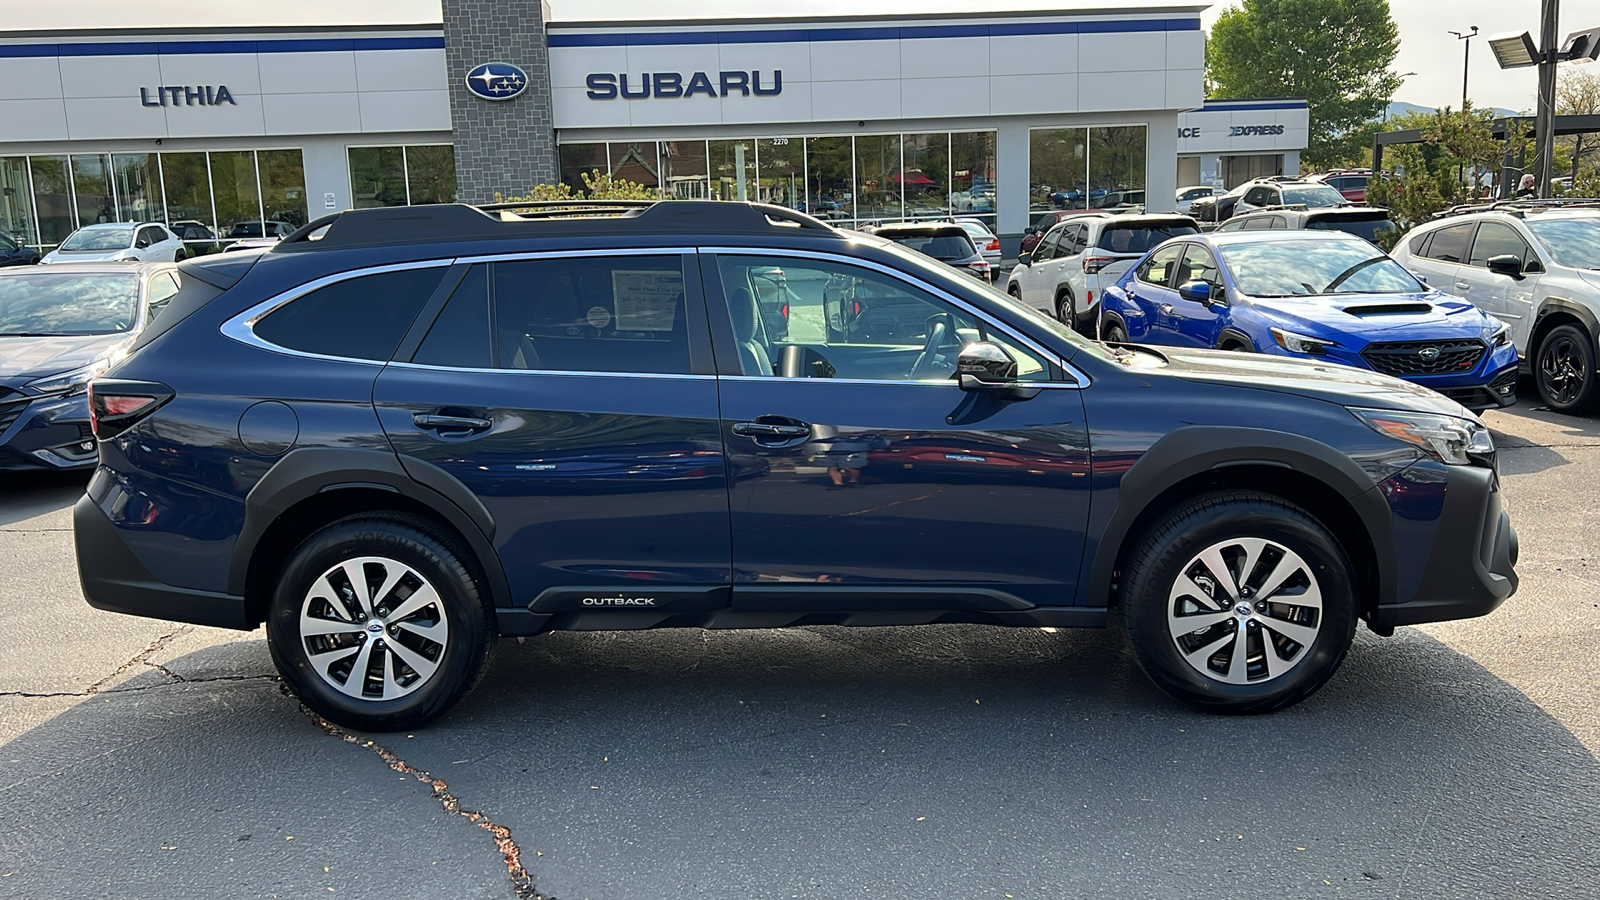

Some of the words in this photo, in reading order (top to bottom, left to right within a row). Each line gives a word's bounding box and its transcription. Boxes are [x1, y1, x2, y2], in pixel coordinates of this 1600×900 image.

[585, 69, 783, 100] SUBARU
[139, 85, 237, 107] LITHIA
[1230, 125, 1285, 137] EXPRESS
[353, 531, 442, 569] YOKOHAMA
[582, 597, 656, 606] OUTBACK
